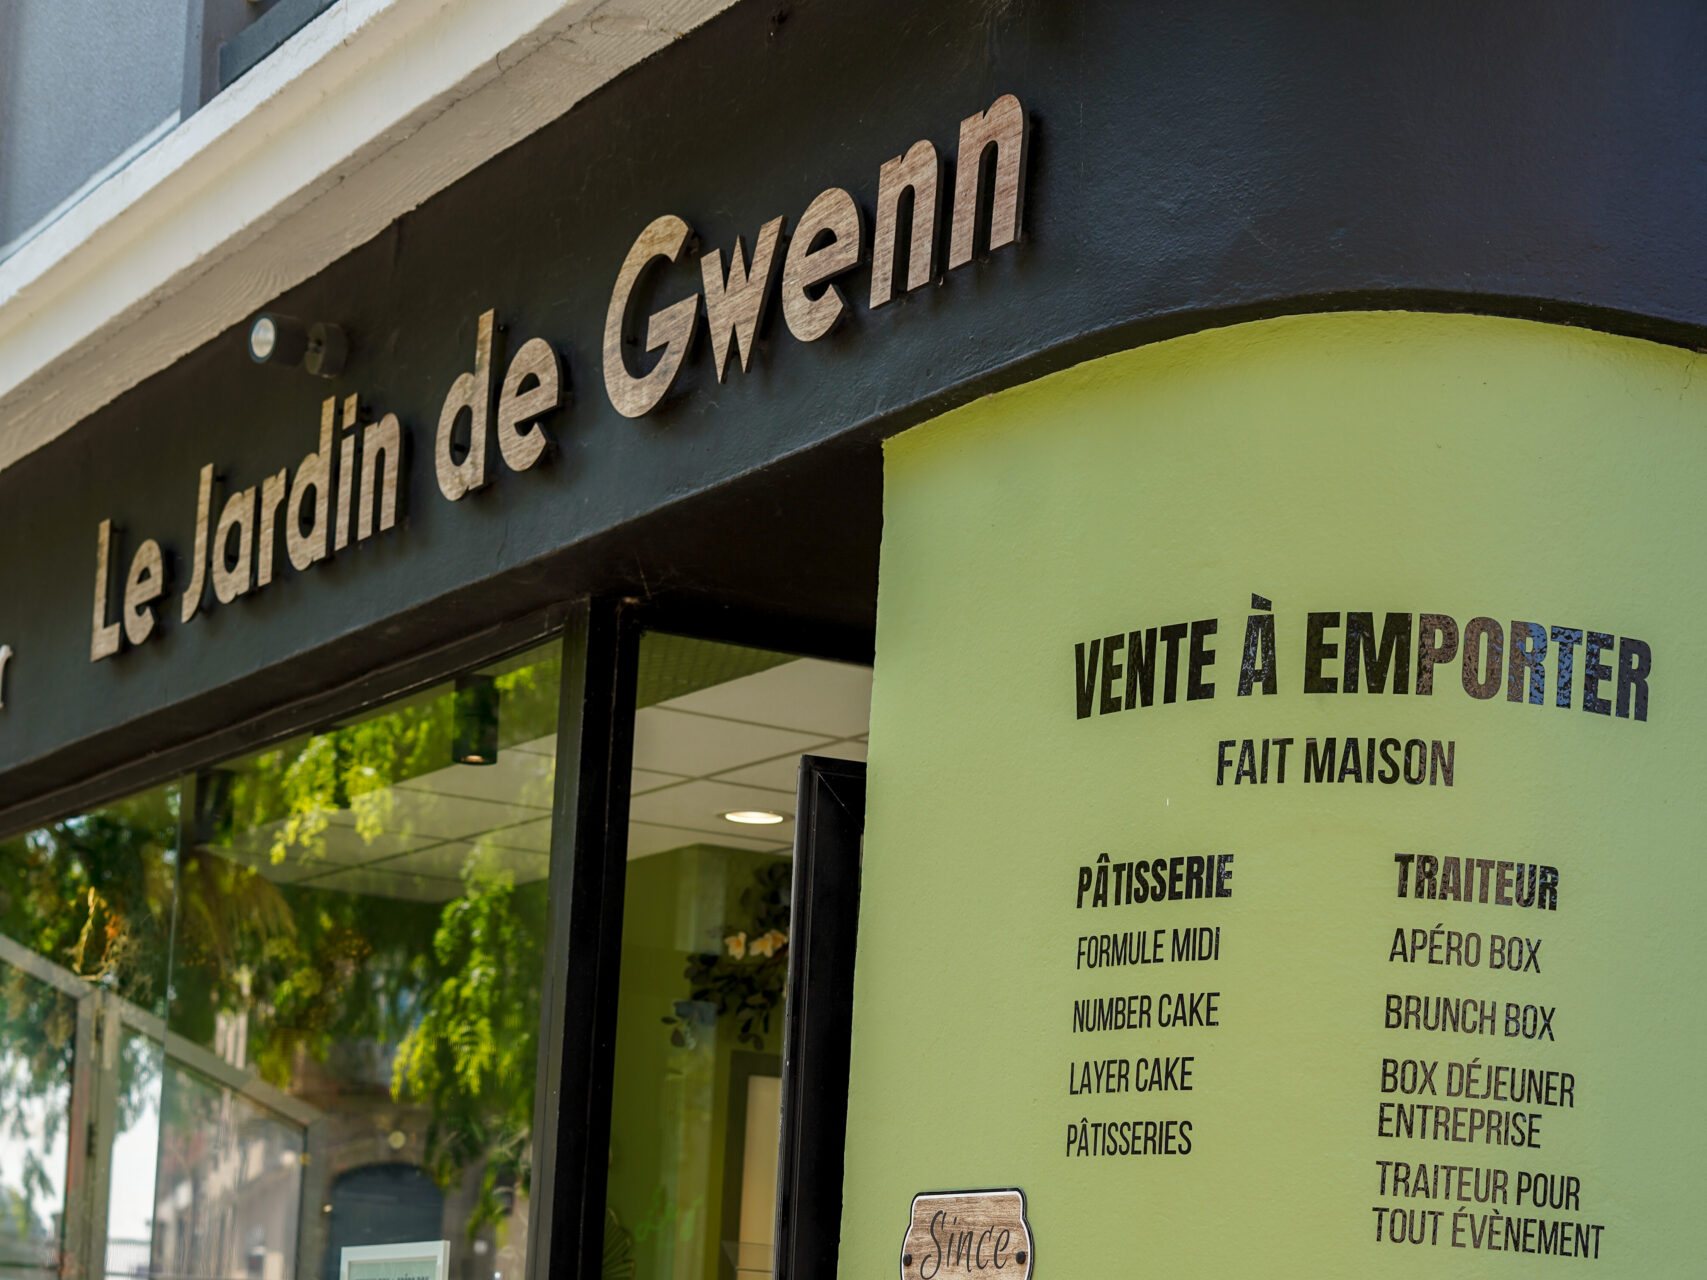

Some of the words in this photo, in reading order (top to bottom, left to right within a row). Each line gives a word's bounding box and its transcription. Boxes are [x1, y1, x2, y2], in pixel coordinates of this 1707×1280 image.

[90, 518, 164, 663] Le
[181, 392, 401, 624] Jardin
[435, 308, 563, 502] de
[602, 93, 1030, 419] Gwenn
[1075, 618, 1218, 720] VENTE
[1237, 593, 1277, 696] À
[1304, 612, 1652, 722] EMPORTER
[1216, 738, 1294, 786] FAIT
[1304, 737, 1455, 787] MAISON
[1076, 853, 1234, 909] PÂTISSERIE
[1394, 853, 1559, 911] TRAITEUR
[1077, 929, 1166, 970] FORMULE
[1171, 927, 1220, 962] MIDI
[1389, 923, 1481, 967] APÉRO
[1489, 935, 1542, 973] BOX
[1073, 995, 1152, 1033] NUMBER
[1158, 992, 1220, 1027] CAKE
[1385, 994, 1496, 1035] BRUNCH
[1504, 1003, 1556, 1041] BOX
[1070, 1059, 1129, 1095] LAYER
[1136, 1057, 1194, 1092] CAKE
[1381, 1058, 1438, 1095] BOX
[1447, 1058, 1576, 1108] DÉJEUNER
[1066, 1117, 1192, 1157] PÂTISSERIES
[1378, 1103, 1542, 1149] ENTREPRISE
[1376, 1161, 1508, 1204] TRAITEUR
[1516, 1171, 1580, 1211] POUR
[920, 1210, 1010, 1280] Since
[1372, 1207, 1444, 1245] TOUT
[1452, 1205, 1606, 1259] ÉVÈNEMENT
